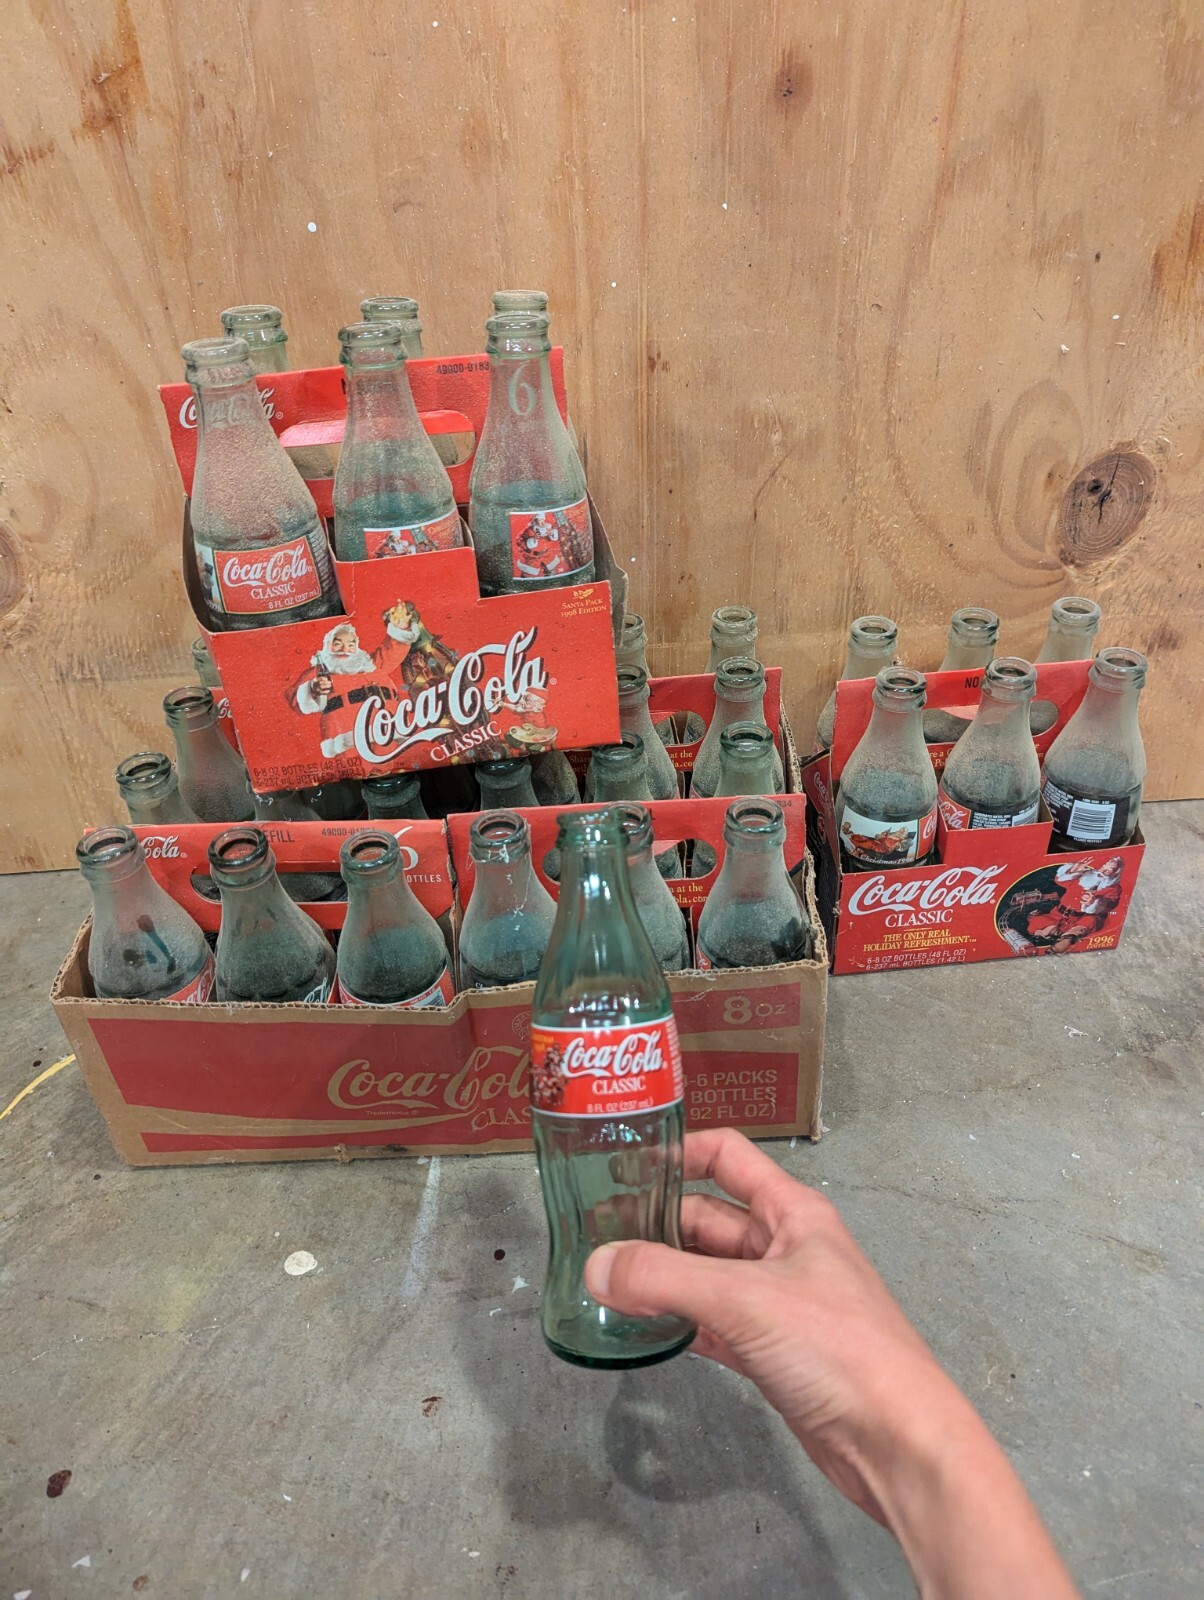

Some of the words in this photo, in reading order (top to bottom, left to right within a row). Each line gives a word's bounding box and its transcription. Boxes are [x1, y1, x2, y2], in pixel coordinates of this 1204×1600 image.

[508, 360, 537, 416] 6
[223, 543, 309, 587] Coca-Cola
[250, 582, 296, 599] CLASSIC
[274, 600, 282, 608] FL
[284, 598, 294, 606] OZ
[295, 592, 308, 603] (237
[561, 609, 577, 617] 1998
[965, 677, 980, 688] NO
[354, 626, 549, 764] Coca-Cola
[430, 721, 502, 762] CLASSIC
[680, 750, 693, 758] the
[282, 763, 319, 775] BOTTLES
[407, 874, 442, 883] OTTLES
[688, 883, 704, 892] the
[848, 864, 1007, 915] Coca-Cola
[885, 909, 954, 928] CLASSIC
[883, 934, 901, 942] THE
[903, 931, 927, 941] ONLY
[928, 929, 951, 938] REAL
[1089, 935, 1116, 945] 1996
[863, 941, 903, 952] HOLIDAY
[866, 963, 887, 971] 6-237
[903, 958, 935, 967] BOTTLES
[937, 956, 957, 965] (1.42
[867, 955, 880, 964] 6-8
[882, 954, 892, 963] OZ
[894, 952, 927, 962] BOTTLES
[929, 950, 941, 959] (48
[954, 948, 966, 956] OZ)
[723, 995, 752, 1024] 8
[560, 1029, 662, 1078] Coca-Cola
[327, 1046, 532, 1110] Coca-Col
[592, 1075, 647, 1096] CLASSIC
[713, 1069, 778, 1086] PACKS
[691, 1087, 777, 1104] BOTTLES
[587, 1104, 593, 1113] 8
[594, 1103, 604, 1112] FL
[606, 1101, 618, 1112] OZ
[618, 1099, 637, 1112] (237
[638, 1097, 654, 1109] mL)
[717, 1105, 740, 1119] FL
[745, 1103, 777, 1119] OZ)
